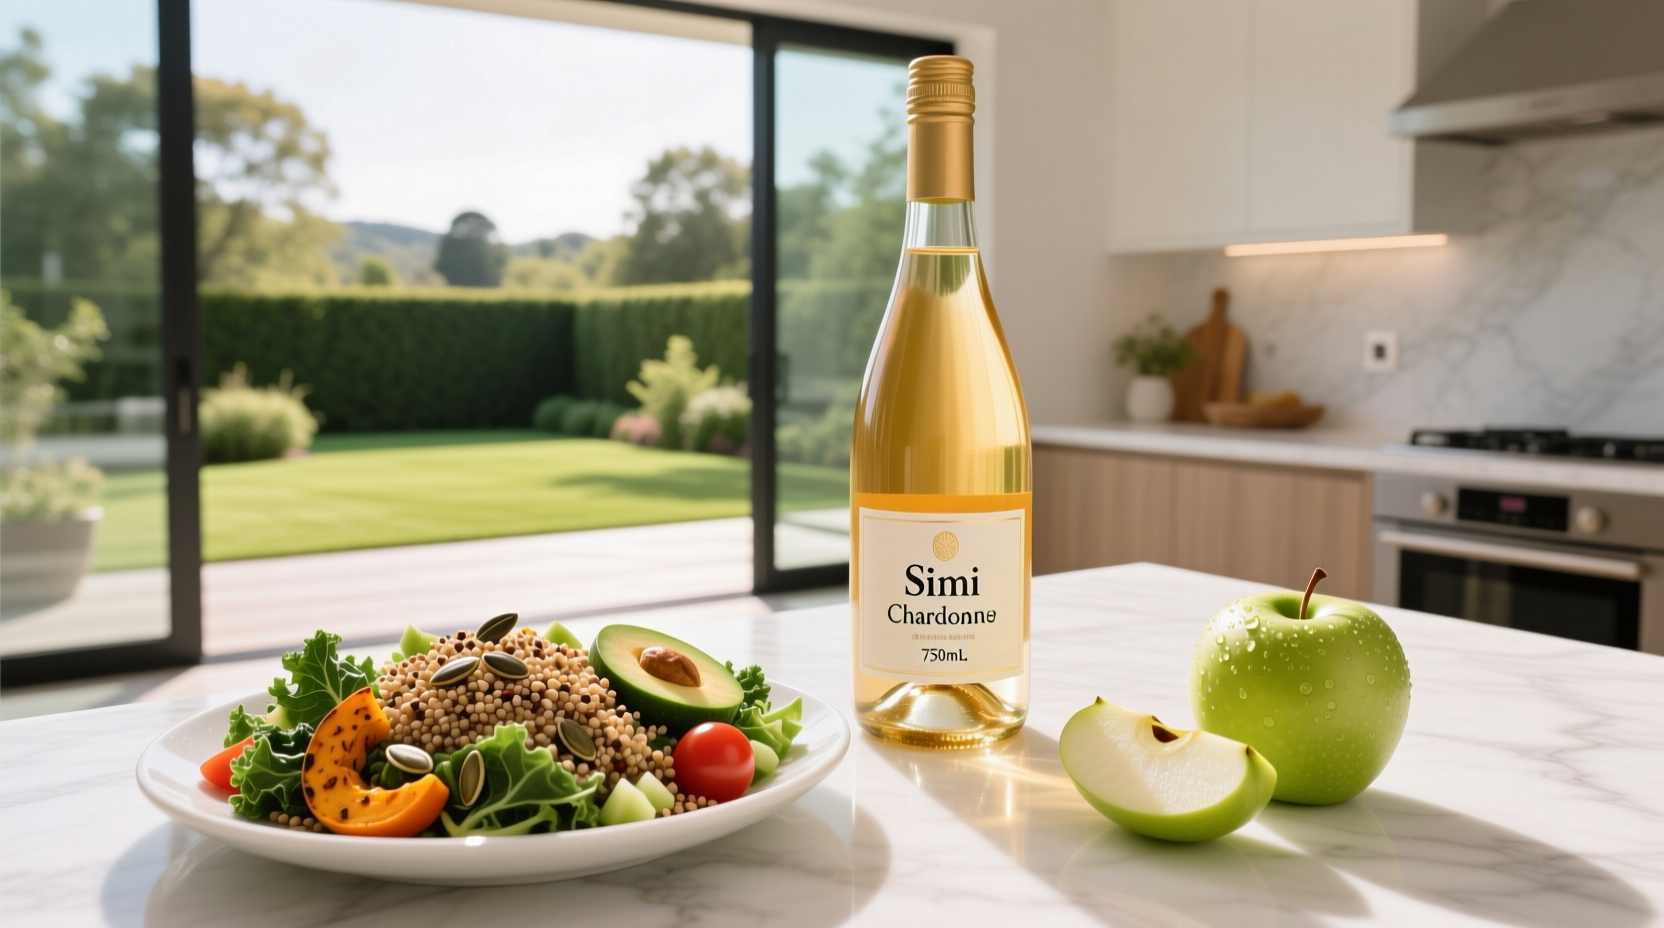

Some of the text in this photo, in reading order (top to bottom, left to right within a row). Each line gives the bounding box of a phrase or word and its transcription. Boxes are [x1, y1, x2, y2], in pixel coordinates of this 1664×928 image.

[904, 563, 980, 597] Simi
[887, 603, 997, 625] Chardonne
[921, 647, 968, 663] 750mL
